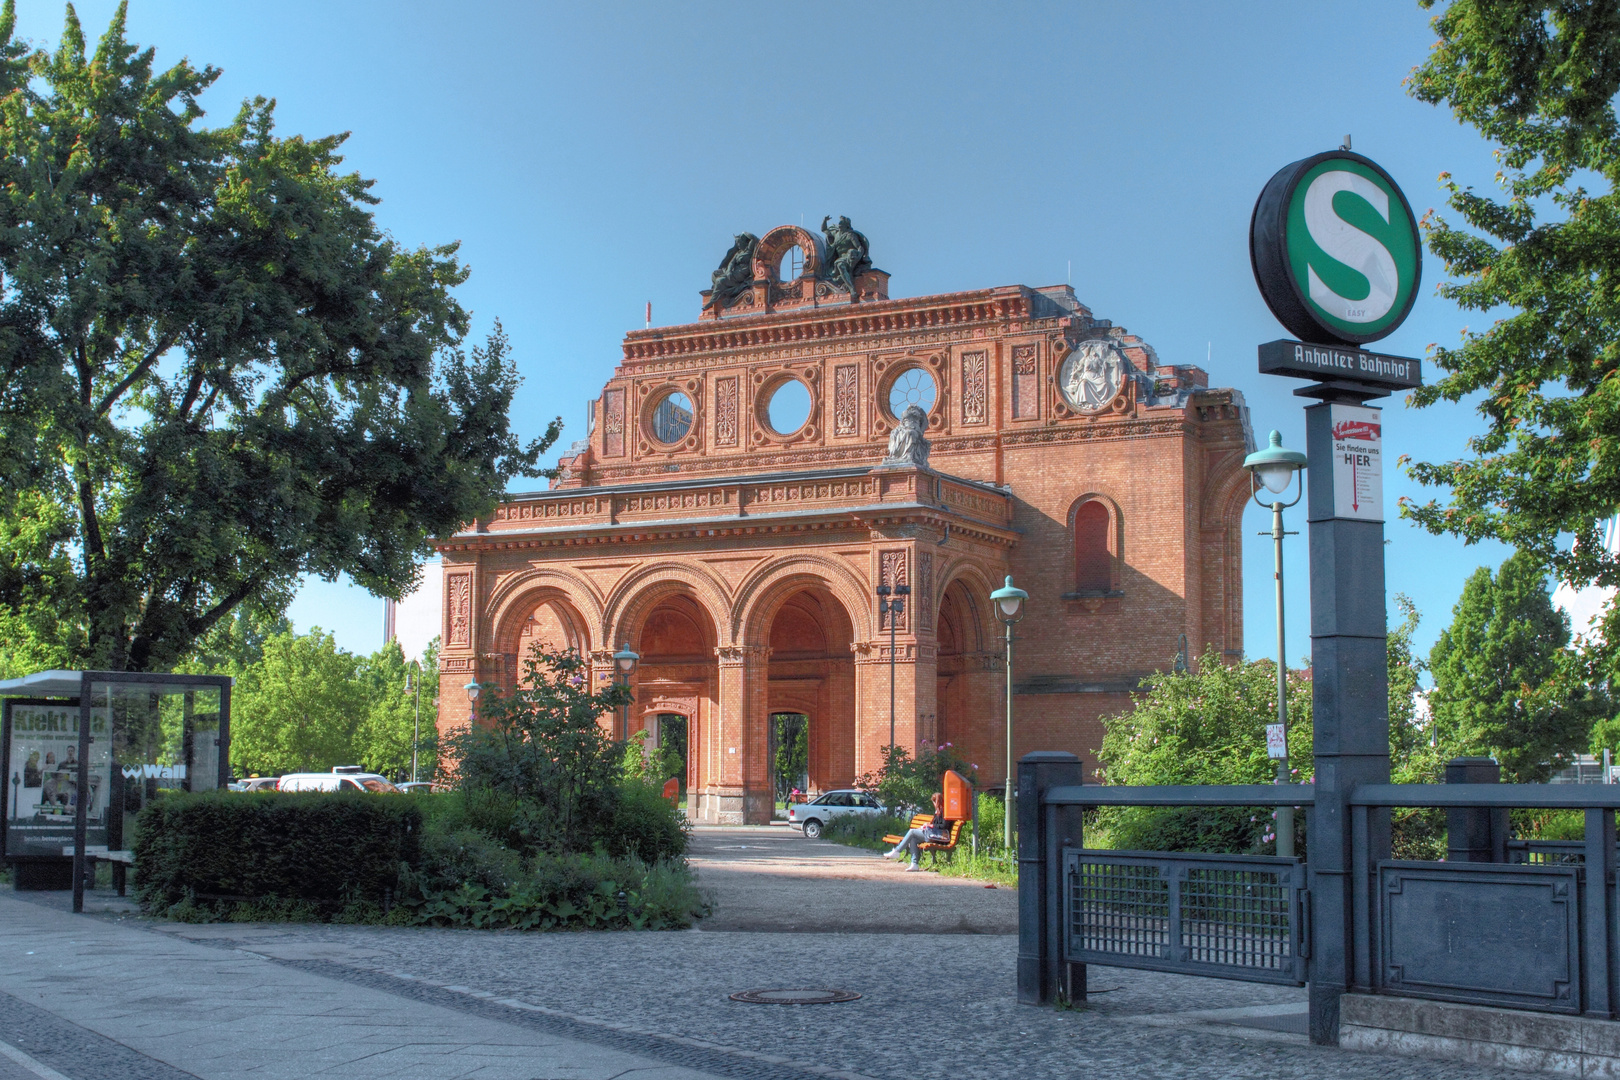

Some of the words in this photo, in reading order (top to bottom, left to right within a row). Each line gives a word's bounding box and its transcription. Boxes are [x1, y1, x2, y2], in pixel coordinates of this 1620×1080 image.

[1304, 170, 1399, 323] S
[1347, 309, 1366, 317] EASY
[1294, 345, 1354, 369] Anhalter
[1359, 354, 1410, 380] Bahnhof
[1336, 443, 1346, 451] Sie
[1347, 444, 1367, 453] finden
[14, 710, 68, 732] Kiekt
[143, 764, 186, 779] Wall
